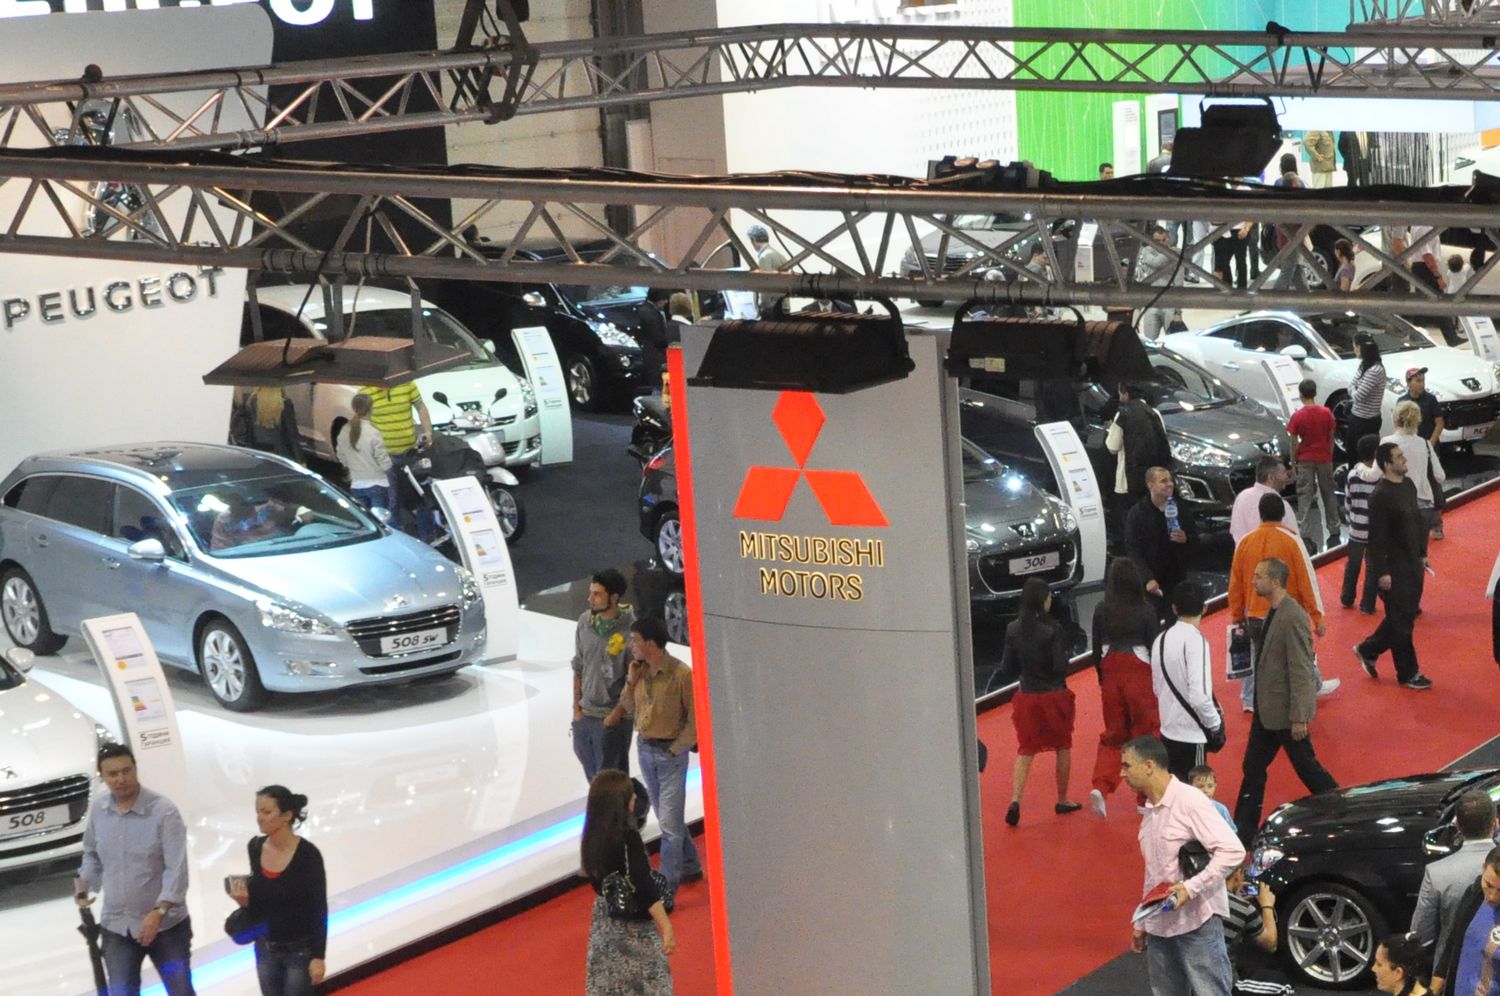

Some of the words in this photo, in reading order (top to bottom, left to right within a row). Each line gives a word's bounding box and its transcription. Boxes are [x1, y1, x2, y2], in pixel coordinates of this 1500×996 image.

[2, 264, 227, 331] PEUGEOT
[739, 530, 884, 567] MITSUBISHI
[1024, 556, 1046, 570] 308
[759, 567, 863, 600] MOTORS
[391, 635, 420, 649] 508
[8, 811, 45, 830] 508
